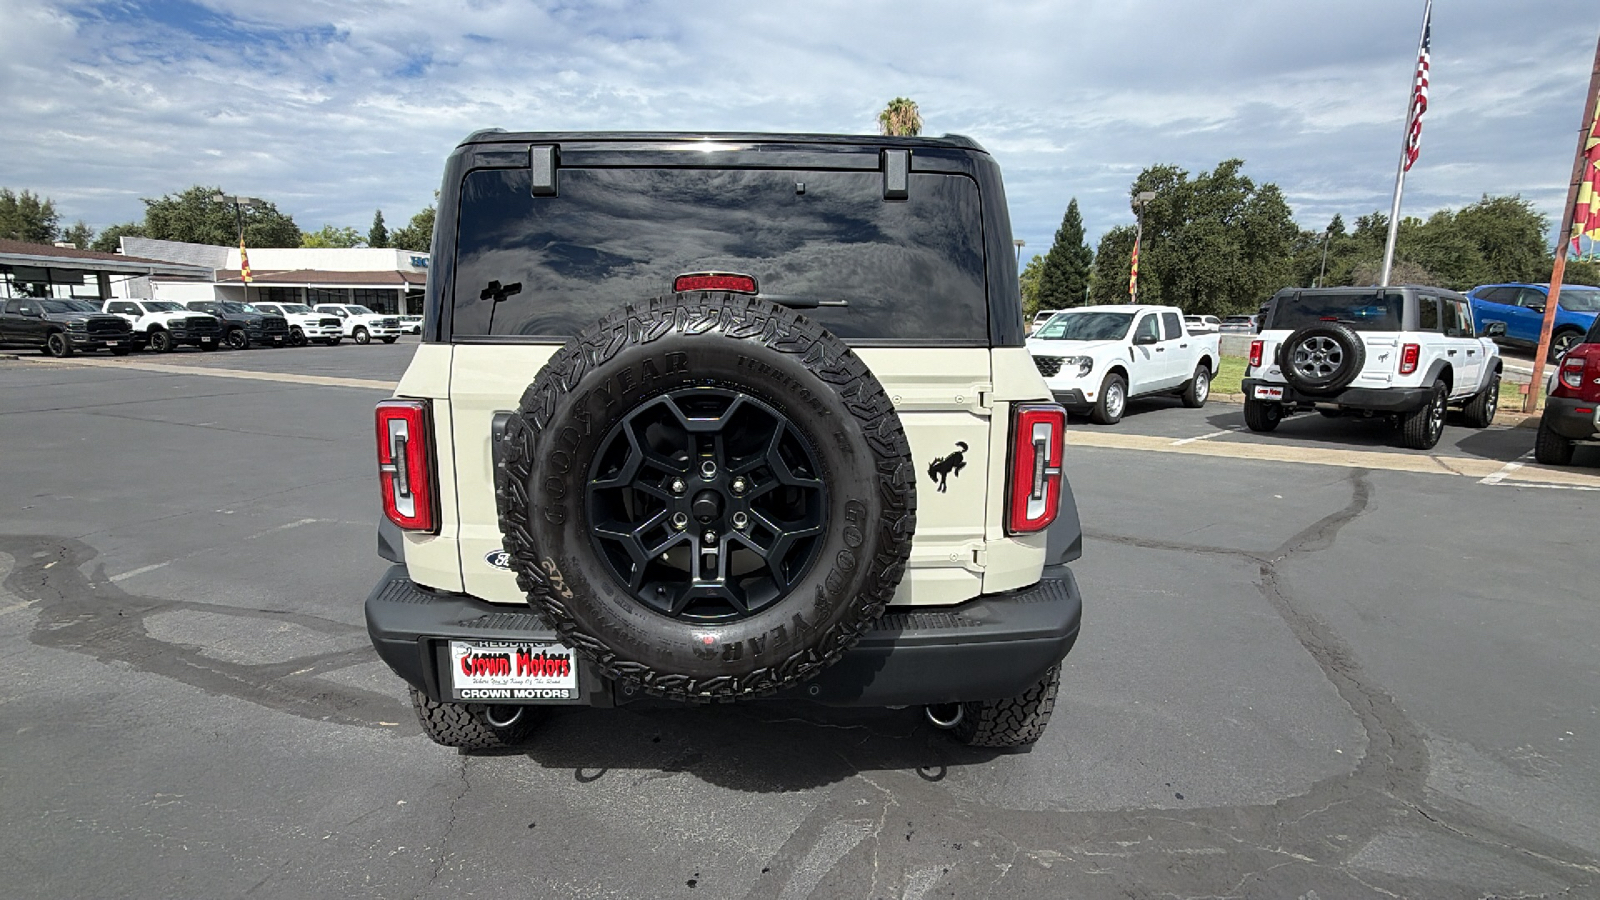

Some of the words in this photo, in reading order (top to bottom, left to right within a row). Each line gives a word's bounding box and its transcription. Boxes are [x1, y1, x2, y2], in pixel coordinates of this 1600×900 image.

[460, 650, 511, 677] Crown
[515, 648, 571, 677] Motors
[461, 689, 511, 699] CROWN
[514, 689, 570, 699] MOTORS
